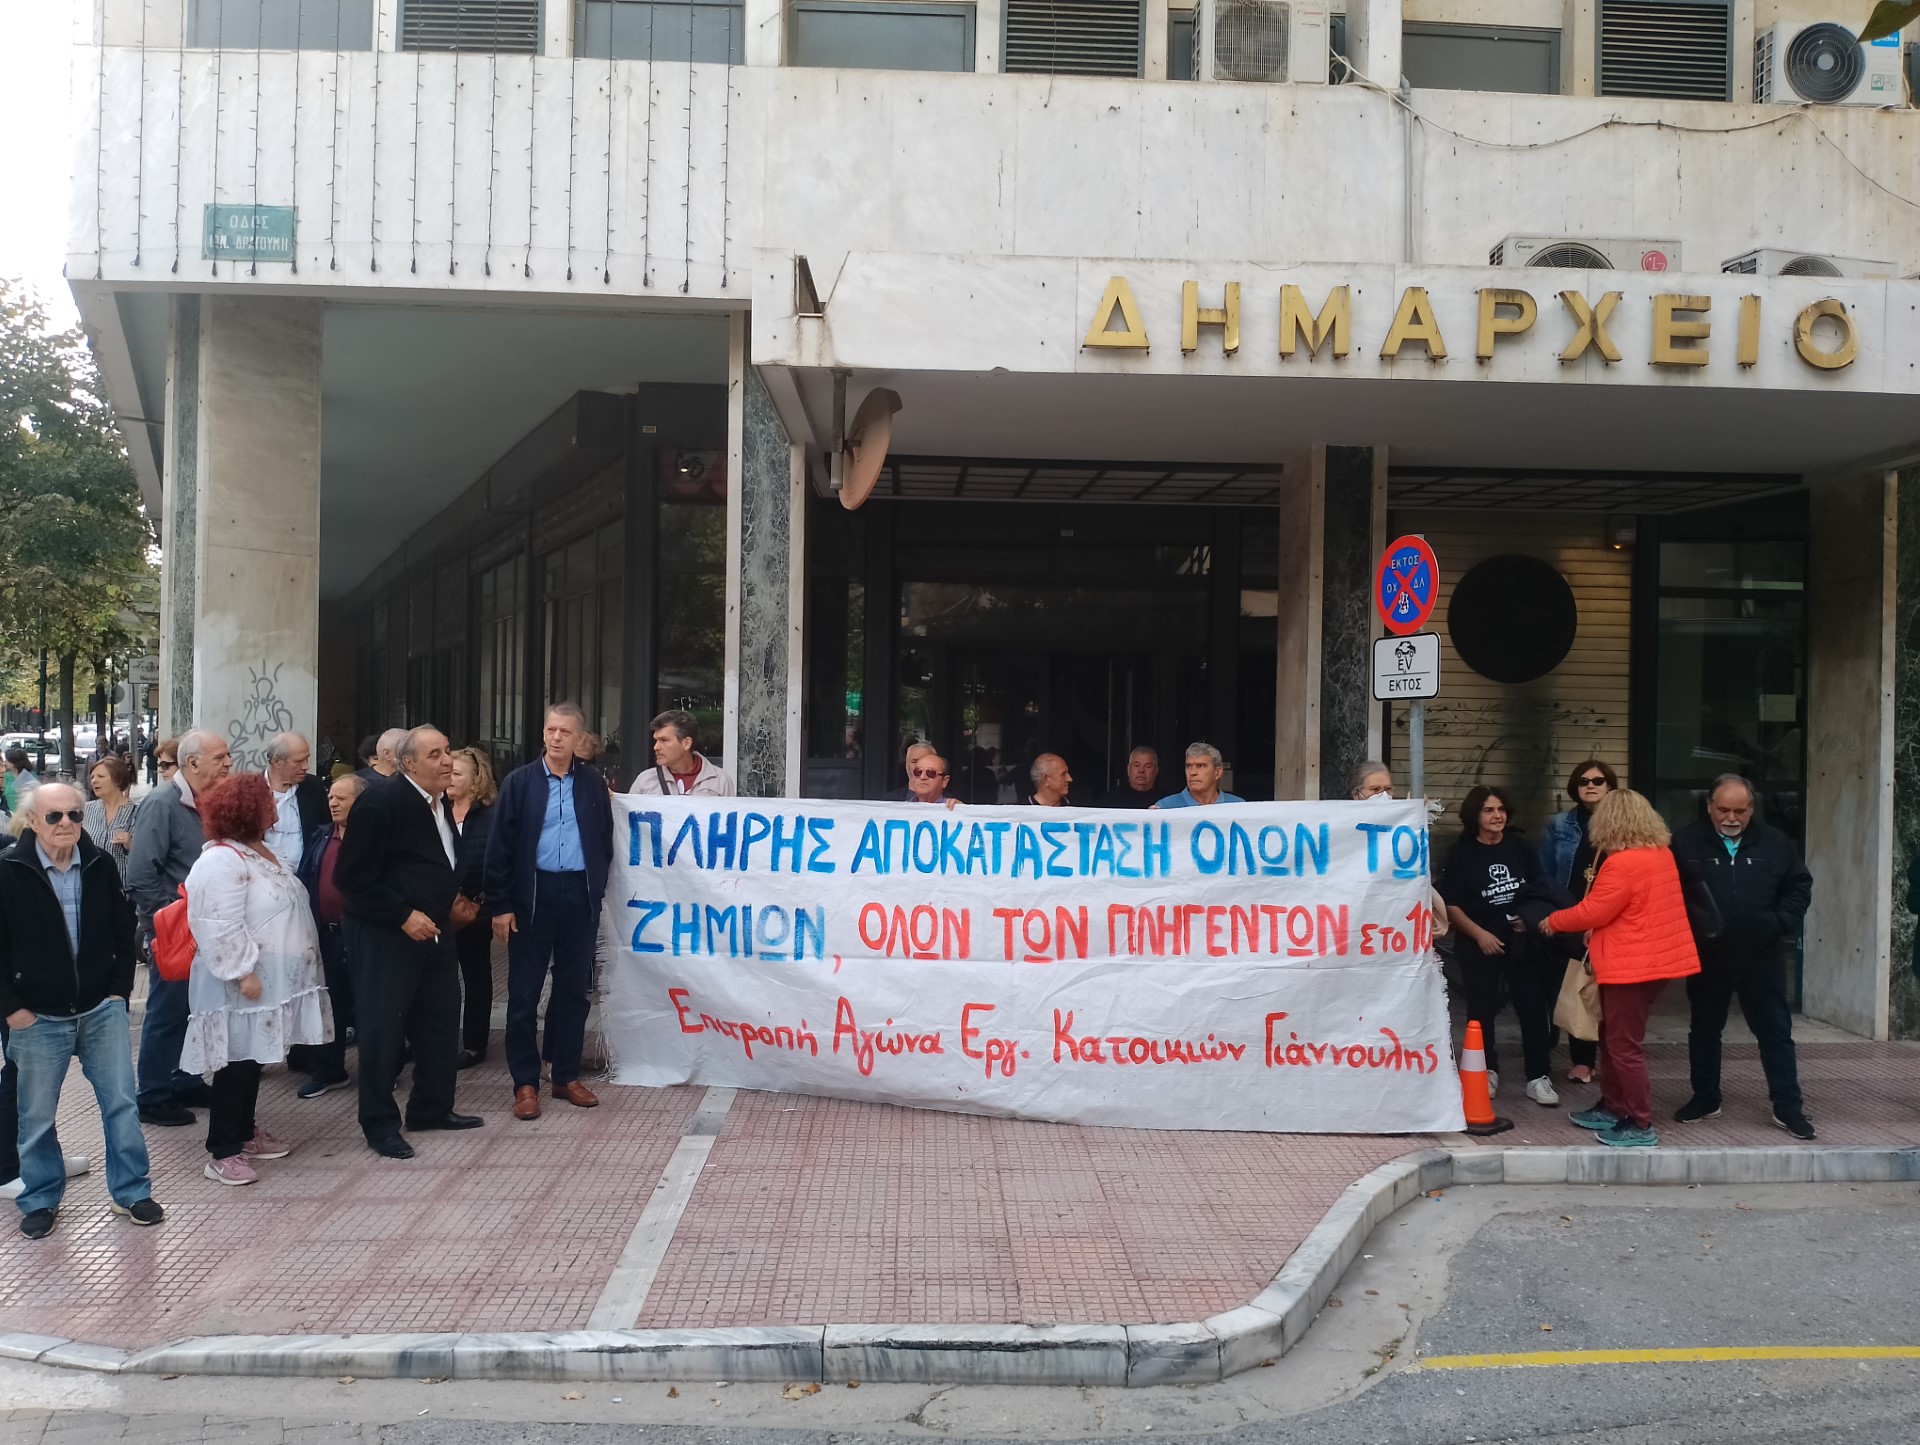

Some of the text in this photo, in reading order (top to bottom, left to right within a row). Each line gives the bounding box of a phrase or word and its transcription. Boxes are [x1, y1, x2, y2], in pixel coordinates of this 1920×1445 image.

[230, 214, 269, 229] ΟΔΟΣ
[235, 234, 289, 252] ΔΡΑΓΟΥΜΗ
[1081, 276, 1861, 372] ΔΗΜΑΡΧΕΙΟ
[1391, 554, 1419, 571] ΕΚΤΟΣ
[1386, 582, 1398, 594] ΟΧ
[1397, 656, 1412, 672] EV
[1389, 677, 1421, 692] ΕΚΤΟΣ
[628, 811, 836, 874] ΠΛΗΡΗΣ
[851, 818, 1171, 880] ΑΠΟΚΑΤΑΣΤΑΣΗ
[1191, 821, 1331, 877] ΟΛΩΝ
[858, 902, 970, 960] ΟΛΩΝ
[993, 907, 1089, 963] ΤΩΝ
[1107, 903, 1349, 958] ΠΛΗΓΕΝΤΩΝ
[668, 987, 1439, 1080] Επιτροπή Αγώνα Εργ. Κατοικιών Γιάννουλης
